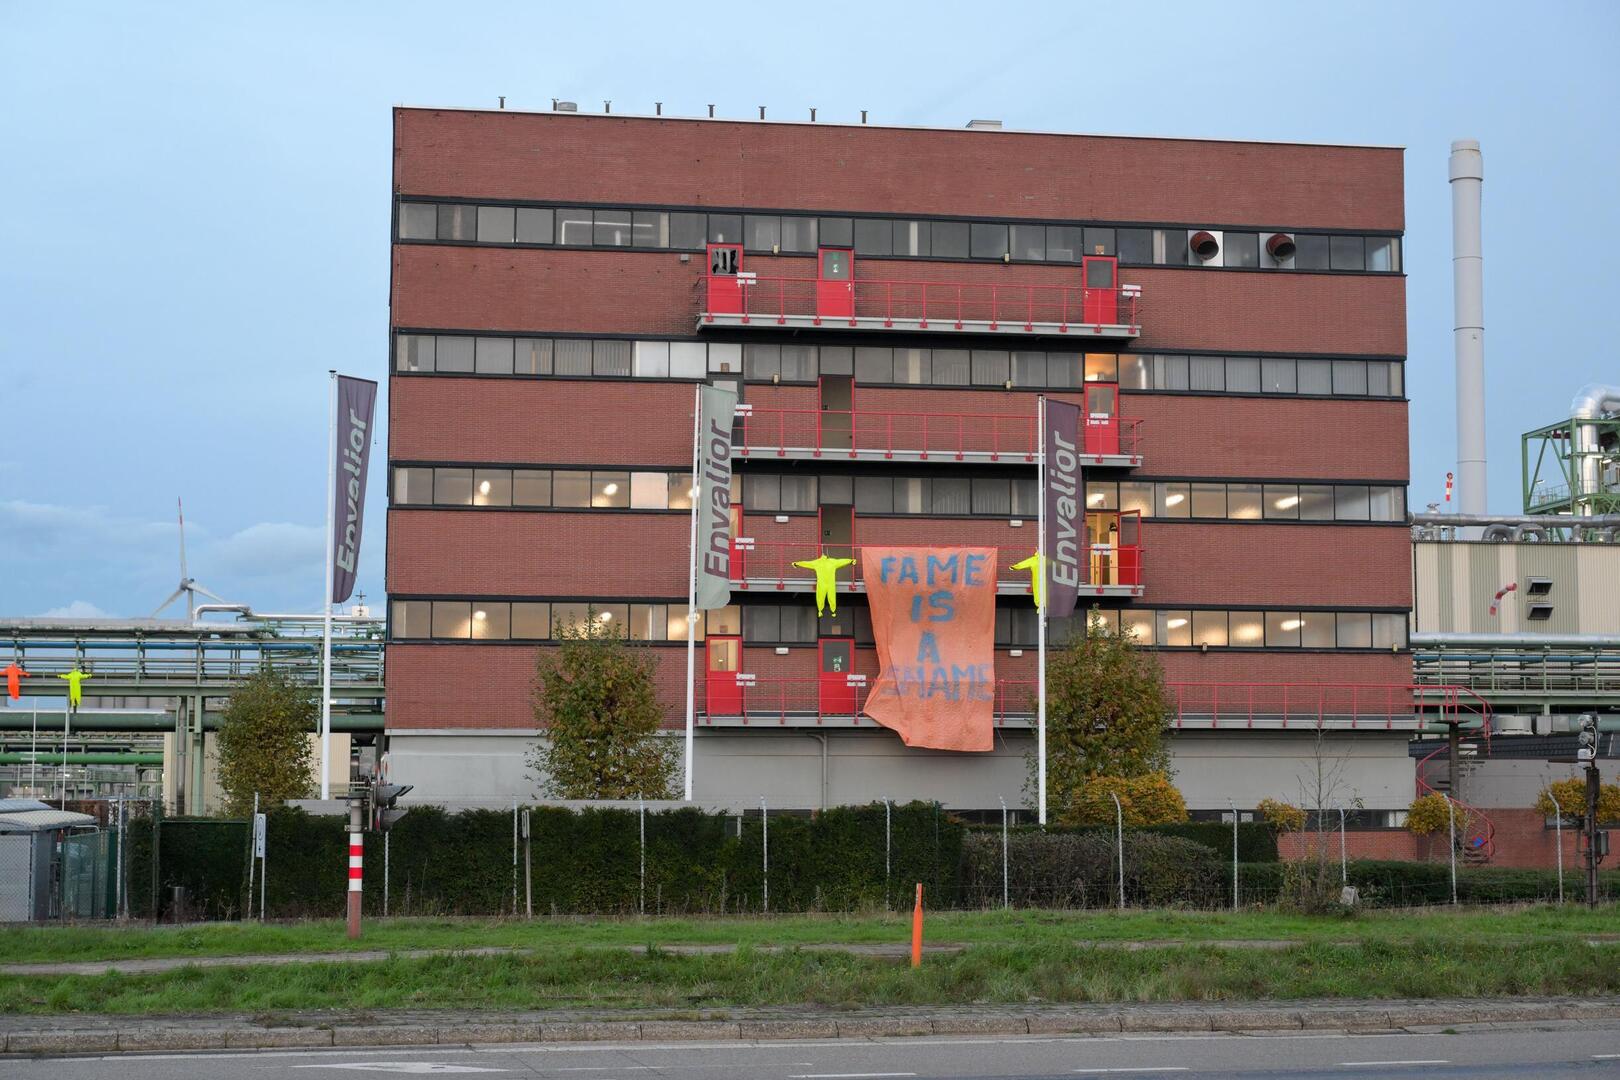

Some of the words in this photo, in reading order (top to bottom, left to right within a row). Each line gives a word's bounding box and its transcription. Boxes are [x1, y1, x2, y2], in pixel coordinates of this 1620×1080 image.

[336, 408, 367, 573] Envalior
[704, 418, 731, 580] Envalior
[1050, 430, 1078, 588] Envalior
[880, 554, 986, 587] FAME
[910, 590, 955, 624] IS
[916, 629, 940, 664] A
